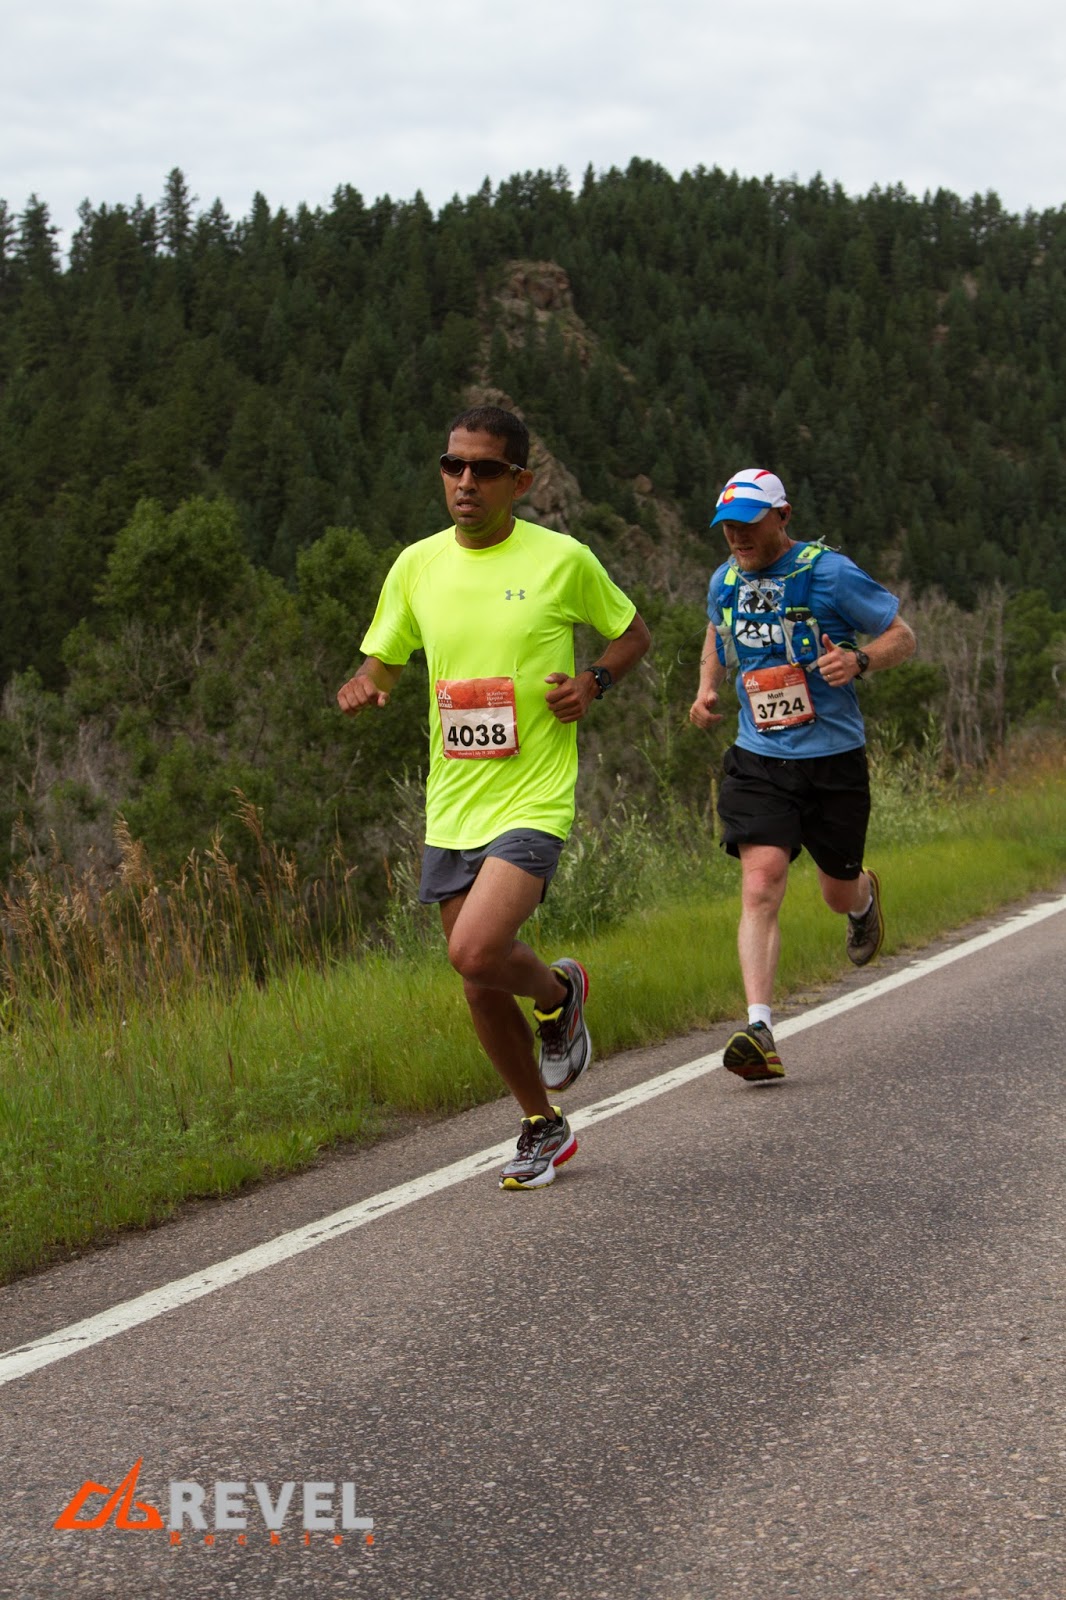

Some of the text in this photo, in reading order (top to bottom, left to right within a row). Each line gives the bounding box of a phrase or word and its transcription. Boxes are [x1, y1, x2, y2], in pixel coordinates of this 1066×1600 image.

[767, 692, 784, 700] Matt
[757, 697, 805, 719] 3724
[447, 723, 507, 747] 4038
